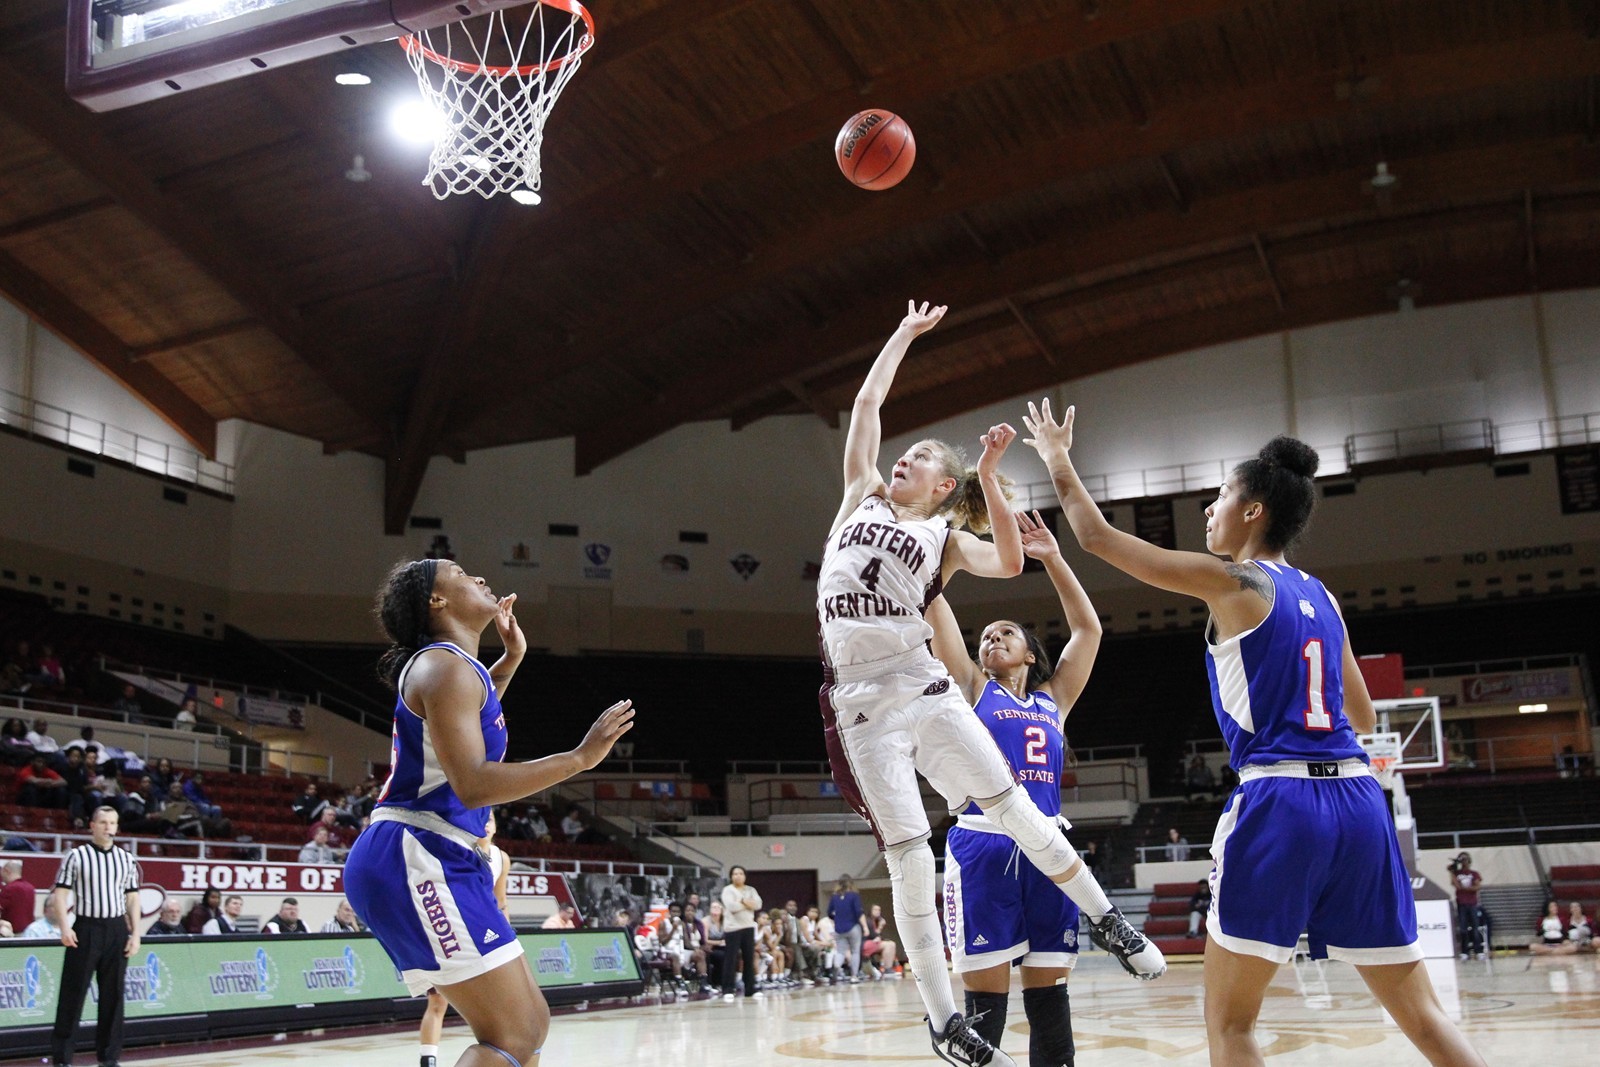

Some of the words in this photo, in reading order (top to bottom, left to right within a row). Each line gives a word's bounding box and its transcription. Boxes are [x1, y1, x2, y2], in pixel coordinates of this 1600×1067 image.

[844, 114, 883, 158] Wilson
[839, 522, 927, 576] EASTERN
[1462, 551, 1488, 565] NO
[1496, 543, 1574, 562] SMOKING
[860, 557, 883, 592] 4
[825, 592, 913, 623] KENTUC
[1303, 638, 1334, 731] 1
[1025, 726, 1048, 765] 2
[1019, 769, 1055, 784] STATE
[181, 864, 287, 889] HOME
[301, 867, 341, 890] OF
[507, 875, 549, 894] ELS
[416, 879, 461, 959] TIGERS
[946, 882, 957, 950] TIGERS
[220, 961, 257, 974] KENTUCKY
[303, 970, 348, 989] LOTTERY
[535, 958, 565, 973] LOTTERY
[209, 974, 259, 994] LOTTERY
